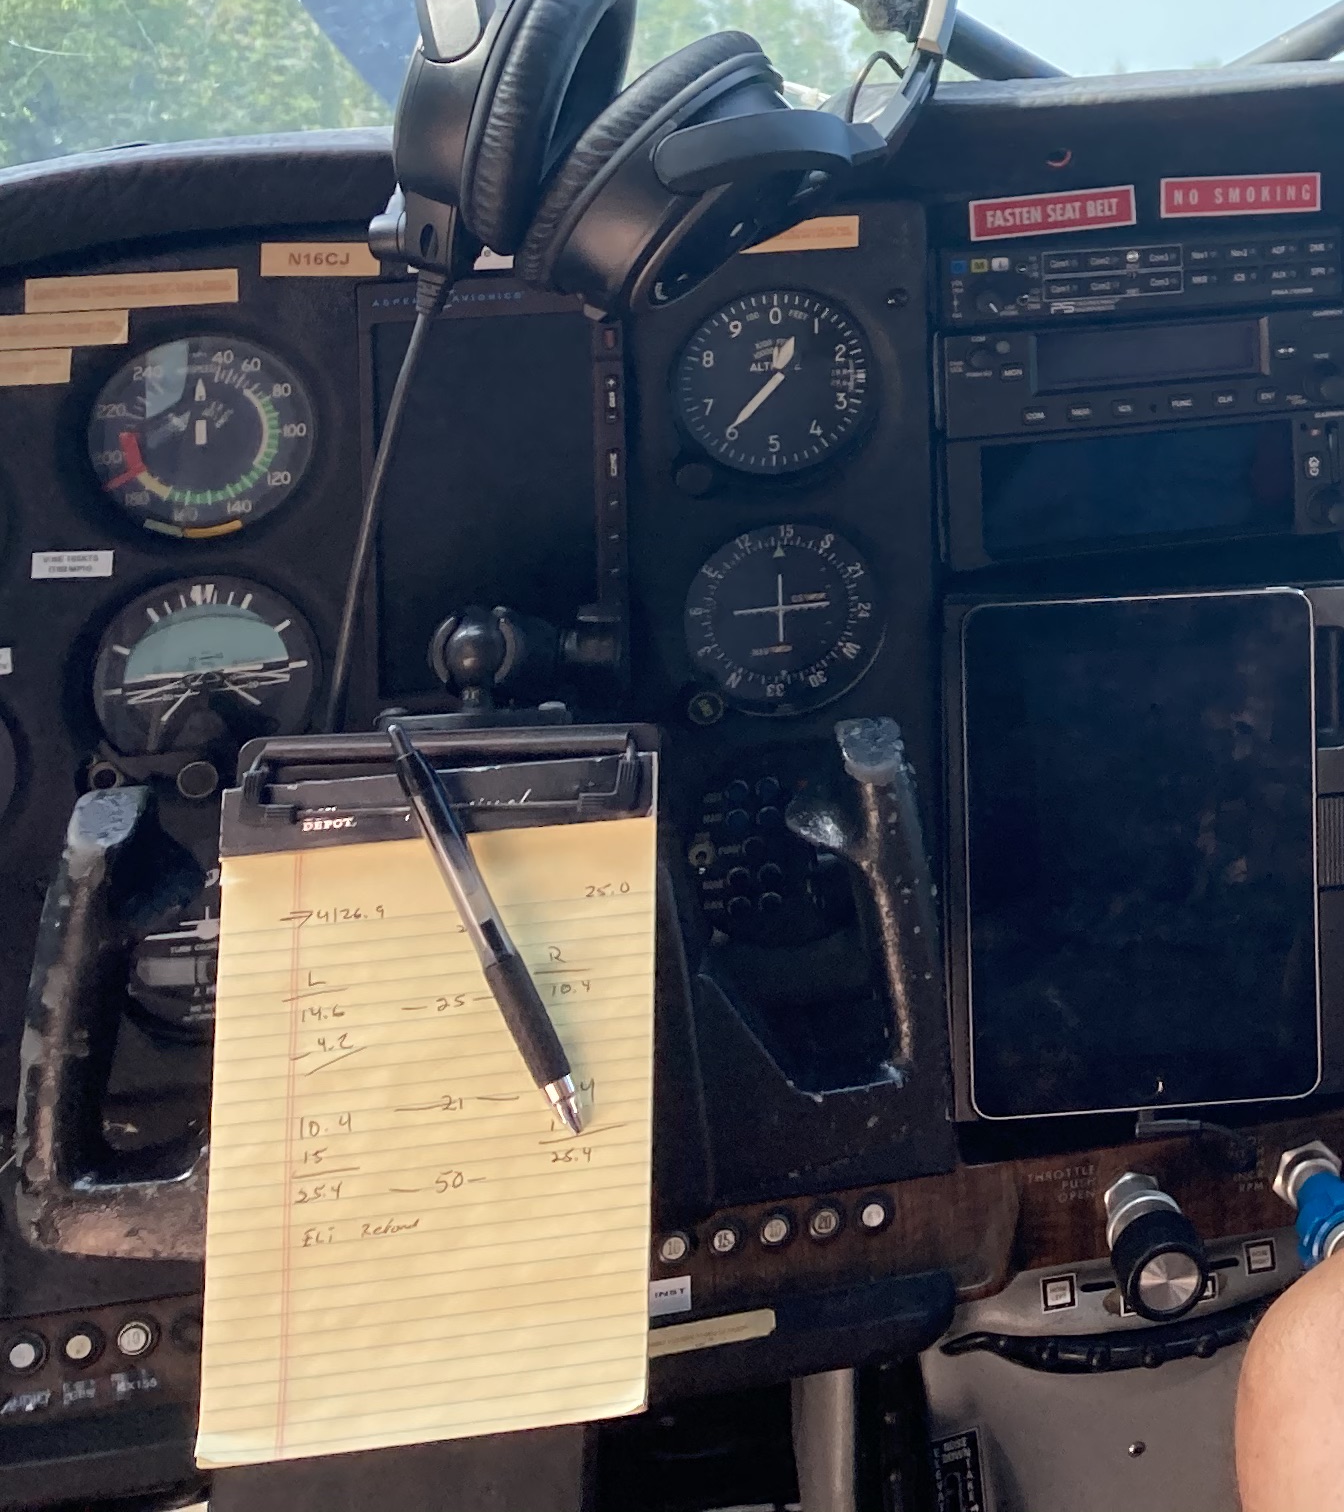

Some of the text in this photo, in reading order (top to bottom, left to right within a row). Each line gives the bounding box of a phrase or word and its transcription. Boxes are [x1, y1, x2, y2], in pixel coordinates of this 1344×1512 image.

[1173, 183, 1312, 206] NO SMOKING
[986, 198, 1120, 229] FASTEN SEAT BELT
[288, 250, 351, 267] N16CJ
[768, 307, 782, 325] 0
[728, 320, 742, 339] 9
[813, 317, 819, 335] 1
[212, 349, 235, 364] 40
[702, 350, 714, 368] 8
[835, 344, 847, 362] 2
[241, 358, 261, 372] 60
[272, 383, 292, 397] 80
[703, 398, 714, 416] 7
[835, 392, 847, 410] 3
[809, 419, 823, 436] 4
[768, 435, 781, 452] 5
[267, 471, 292, 486] 120
[227, 500, 253, 514] 140
[779, 525, 794, 538] 15
[585, 881, 631, 899] 25.0
[548, 945, 567, 964] R
[307, 970, 327, 987] L
[301, 1003, 346, 1023] 14.6
[299, 1111, 352, 1140] 10.4
[550, 1146, 593, 1164] 25.4
[1027, 1165, 1096, 1184] THROTTLE
[1057, 1190, 1096, 1204] OPEN
